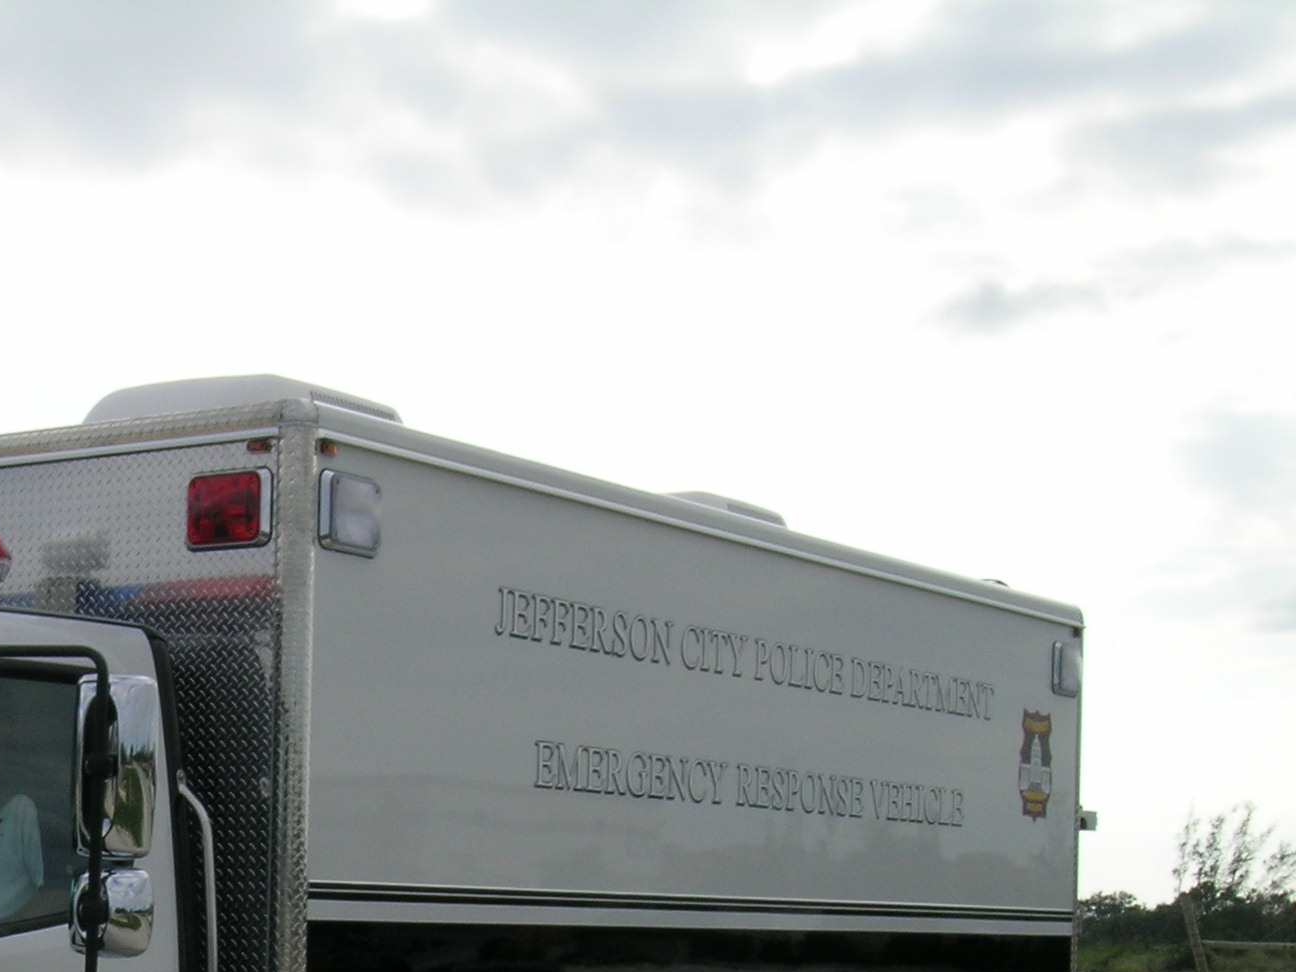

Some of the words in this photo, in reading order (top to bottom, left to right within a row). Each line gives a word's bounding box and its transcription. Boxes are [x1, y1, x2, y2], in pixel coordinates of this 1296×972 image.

[495, 586, 674, 666] JEFFERSON
[681, 624, 748, 678] CITY
[754, 638, 843, 696] POLICE
[851, 657, 995, 721] DEPARTMENT
[534, 740, 728, 805] EMERGENCY
[736, 763, 864, 819] RESPONSE
[870, 779, 966, 828] VEHICLE
